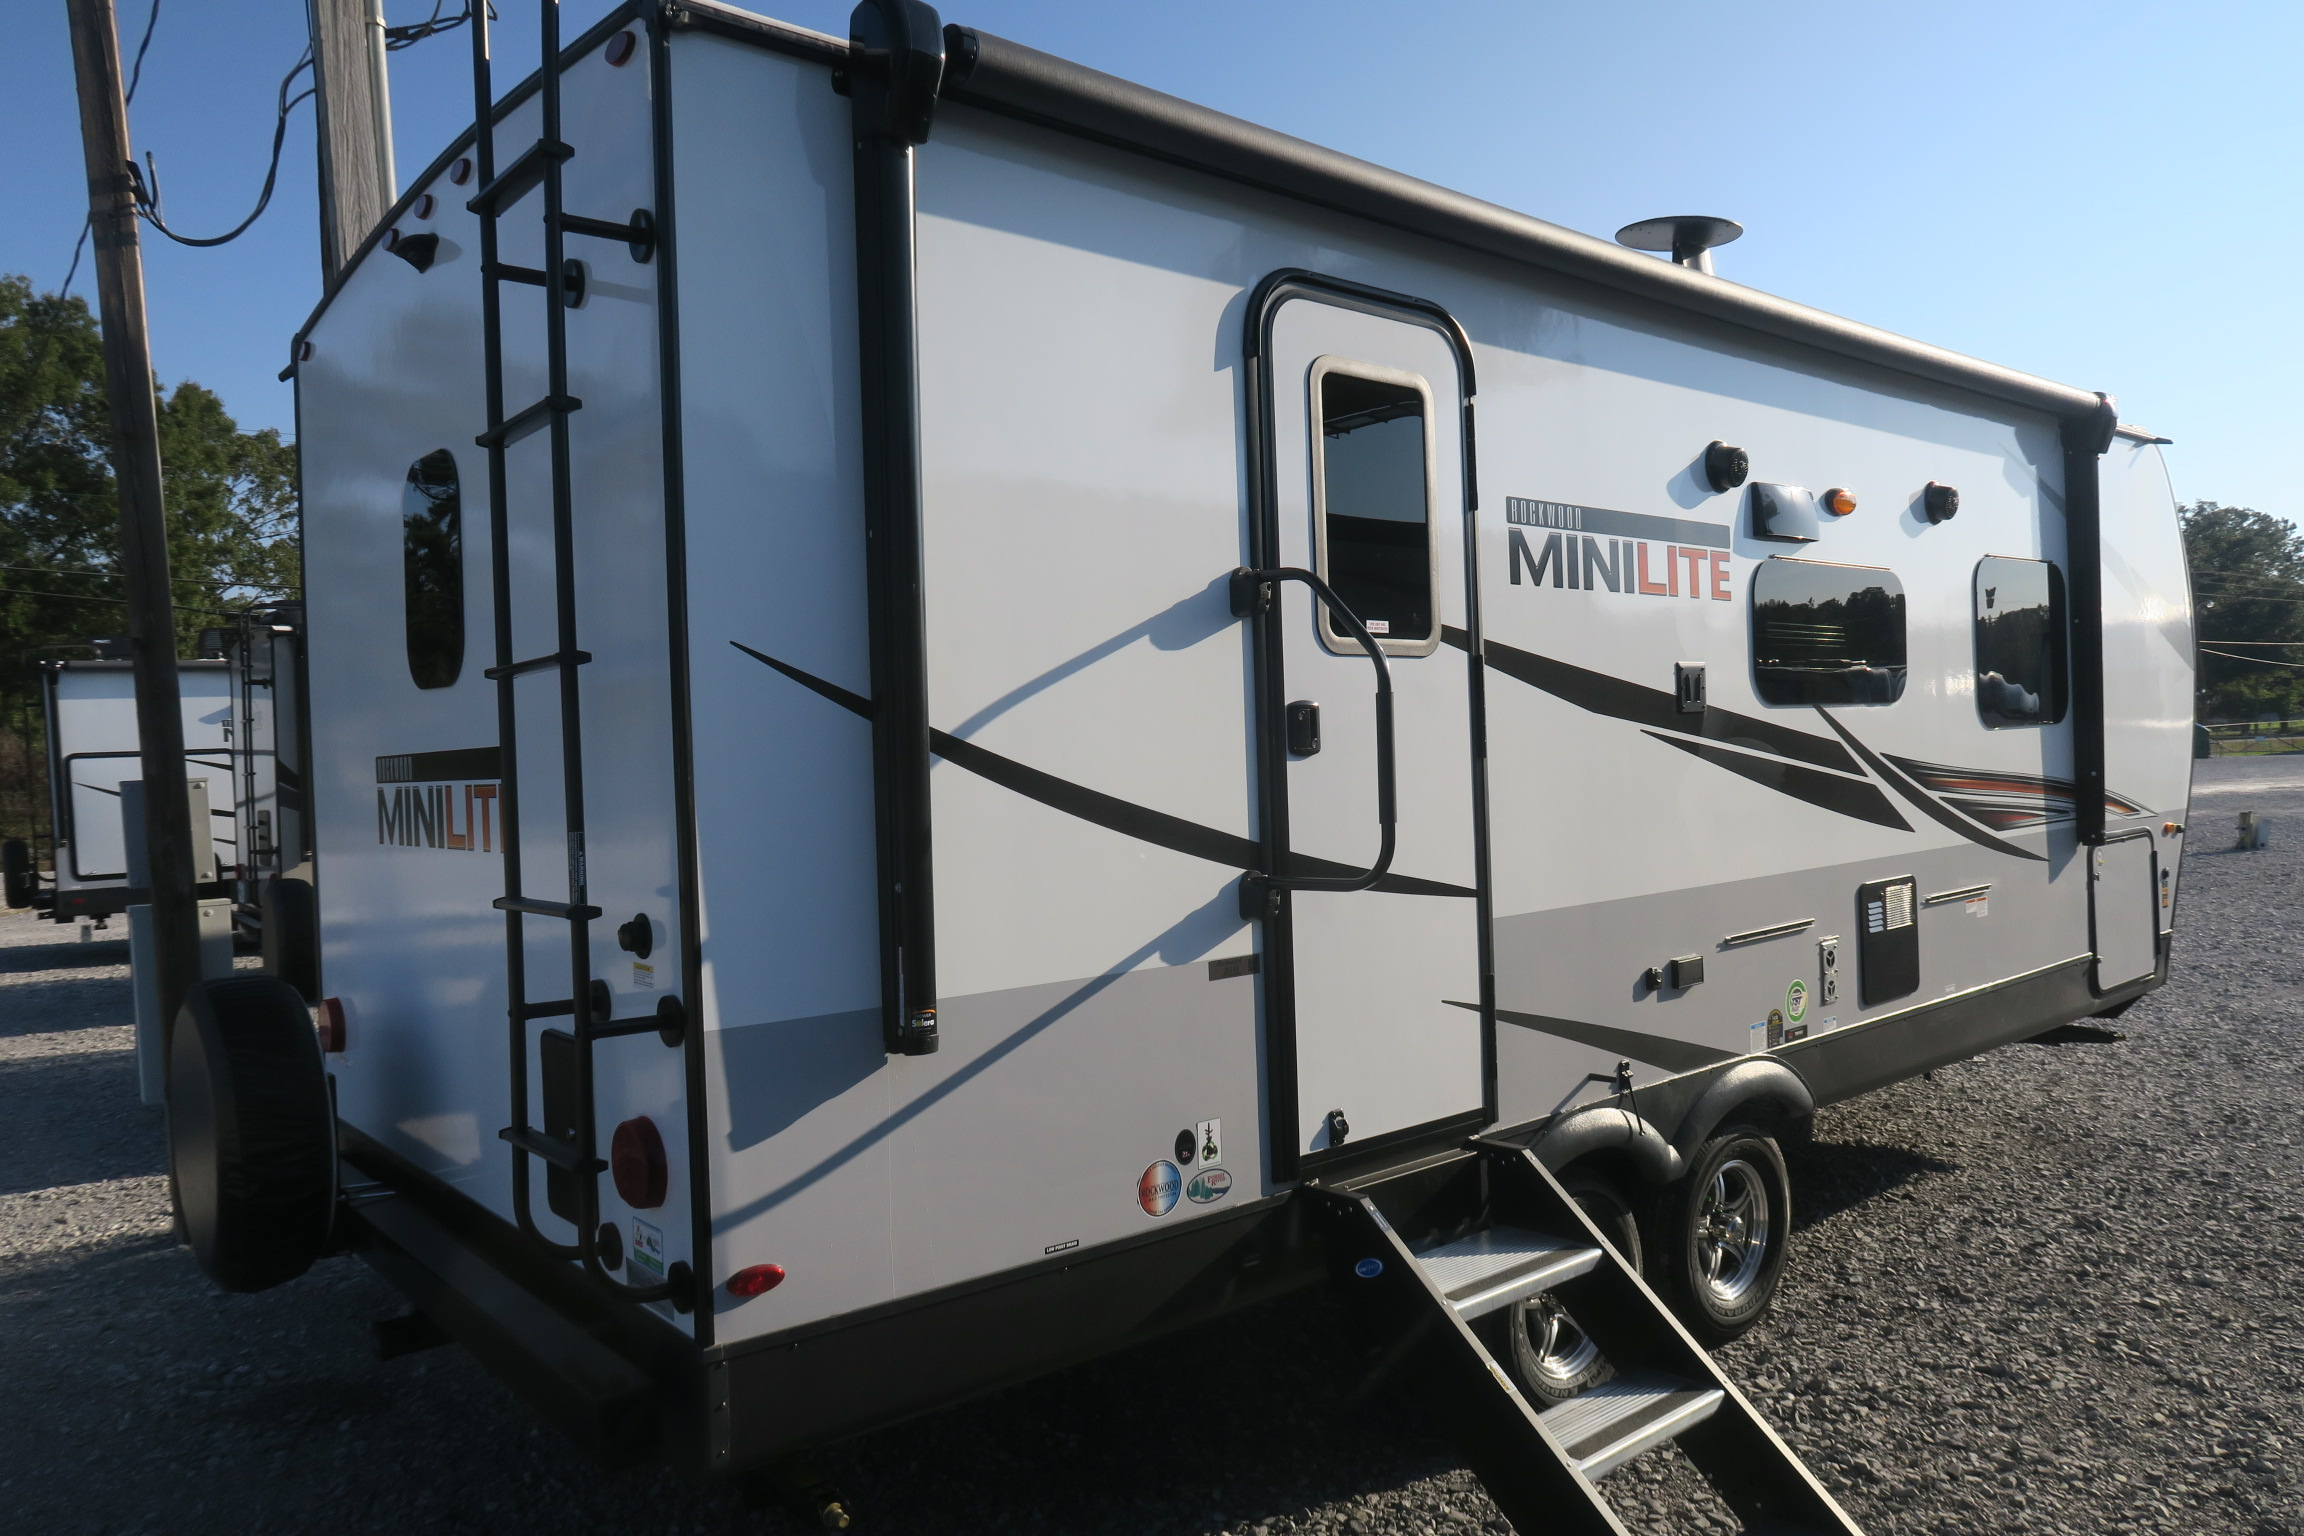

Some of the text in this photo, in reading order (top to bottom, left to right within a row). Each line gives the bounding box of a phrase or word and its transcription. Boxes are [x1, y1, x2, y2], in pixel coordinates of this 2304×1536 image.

[1511, 499, 1581, 529] ROCKWOOD
[1508, 527, 1732, 601] MINILITE
[377, 784, 504, 853] MINILIT
[911, 1018, 935, 1027] Solera
[1141, 1180, 1179, 1198] ROCKWOOD
